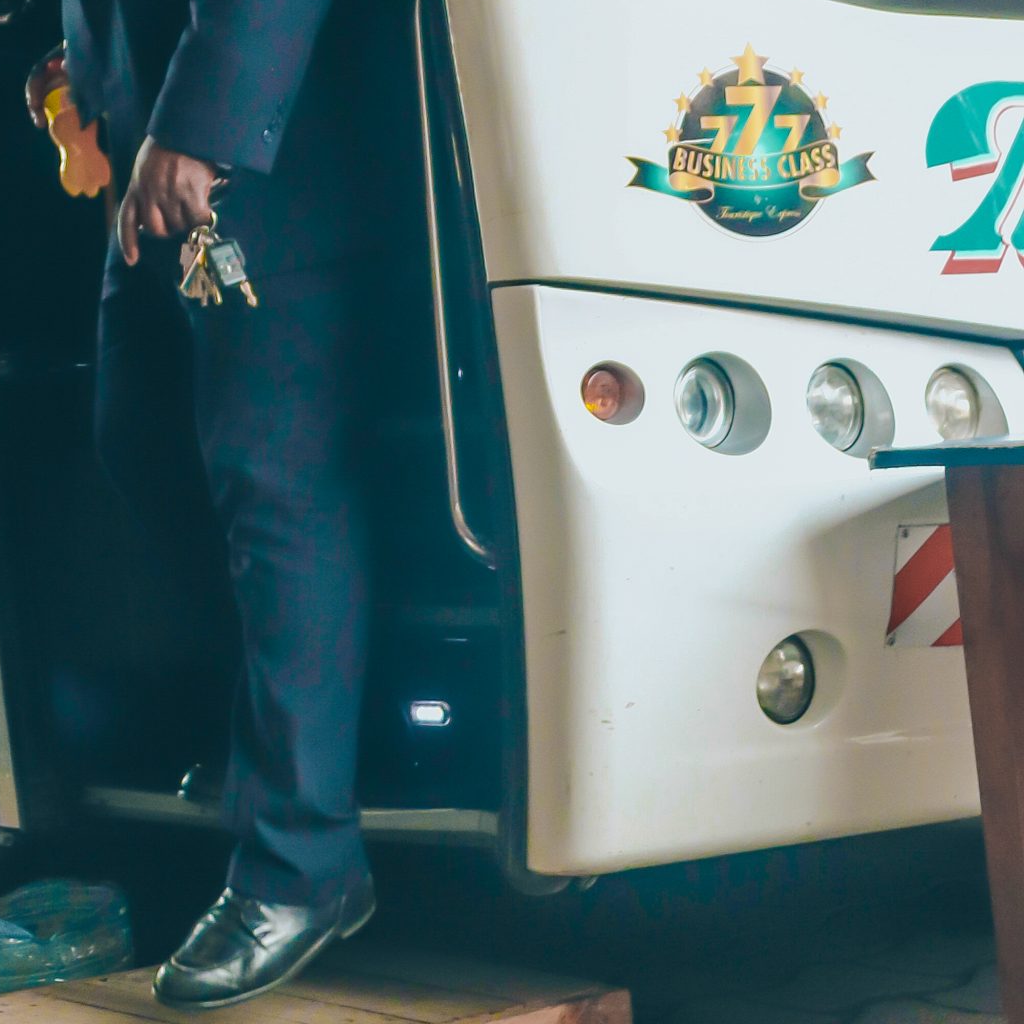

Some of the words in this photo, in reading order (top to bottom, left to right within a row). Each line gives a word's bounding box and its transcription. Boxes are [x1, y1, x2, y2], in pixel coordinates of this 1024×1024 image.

[699, 85, 811, 156] 777
[672, 146, 771, 181] BUSINESS
[776, 143, 836, 180] CLASS
